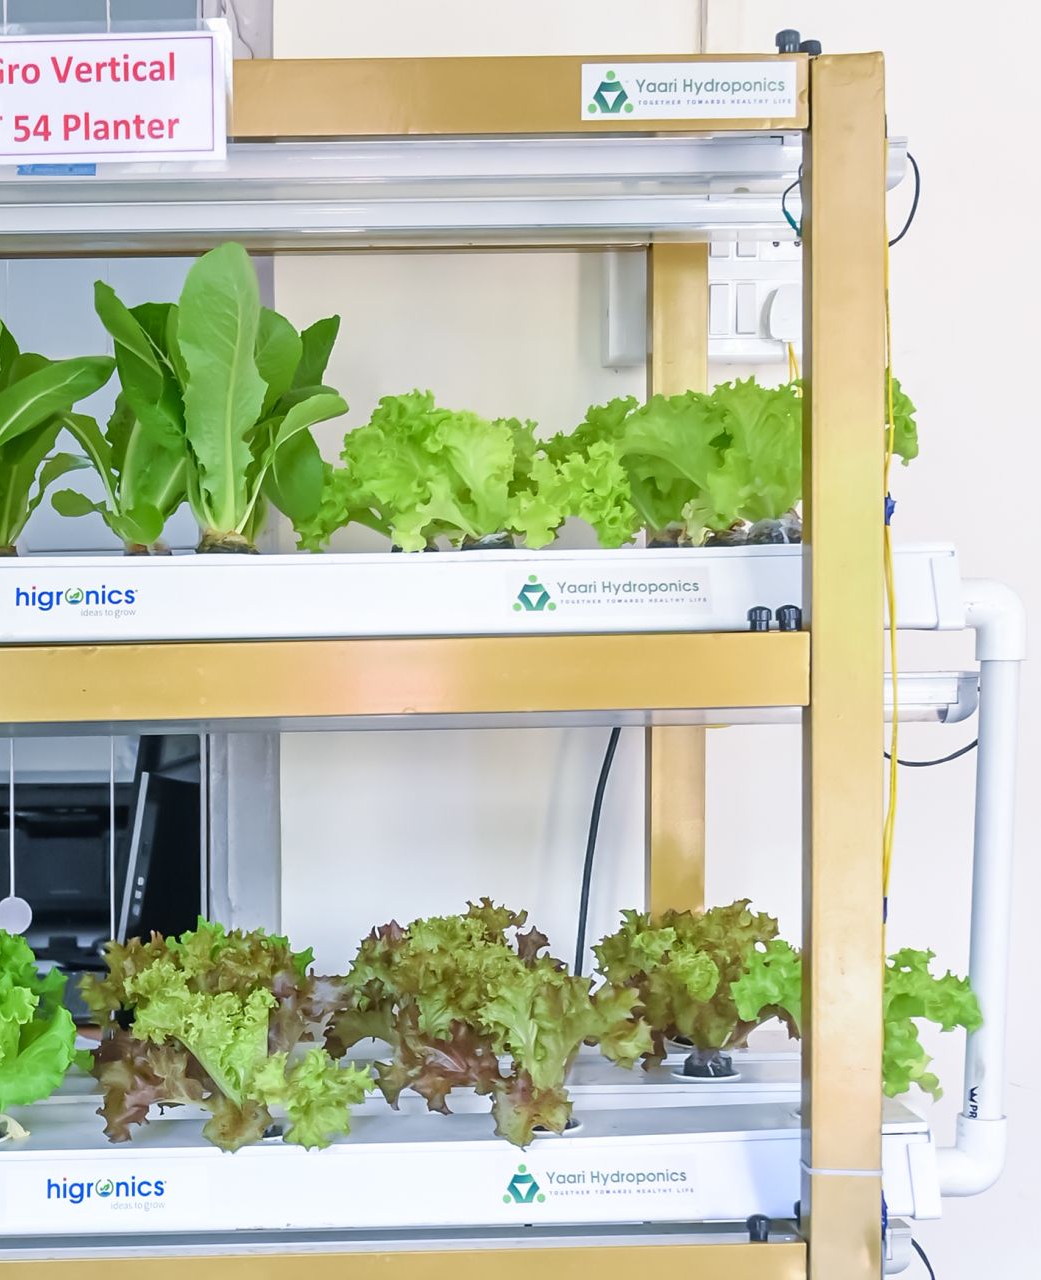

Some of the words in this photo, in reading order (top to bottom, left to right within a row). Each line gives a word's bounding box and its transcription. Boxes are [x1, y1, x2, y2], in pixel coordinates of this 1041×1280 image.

[51, 52, 176, 83] Vertical
[635, 78, 677, 93] Yaari
[682, 77, 786, 96] Hydroponics
[13, 114, 52, 143] 54
[62, 111, 180, 141] Planter
[15, 584, 136, 612] higronics
[557, 581, 597, 594] Yaari
[602, 579, 700, 596] Hydroponics
[80, 608, 103, 617] ideas
[104, 609, 114, 617] to
[114, 608, 137, 619] grow
[545, 1170, 586, 1185] Yaari
[590, 1169, 687, 1186] Hydroponics
[47, 1175, 165, 1204] higronics
